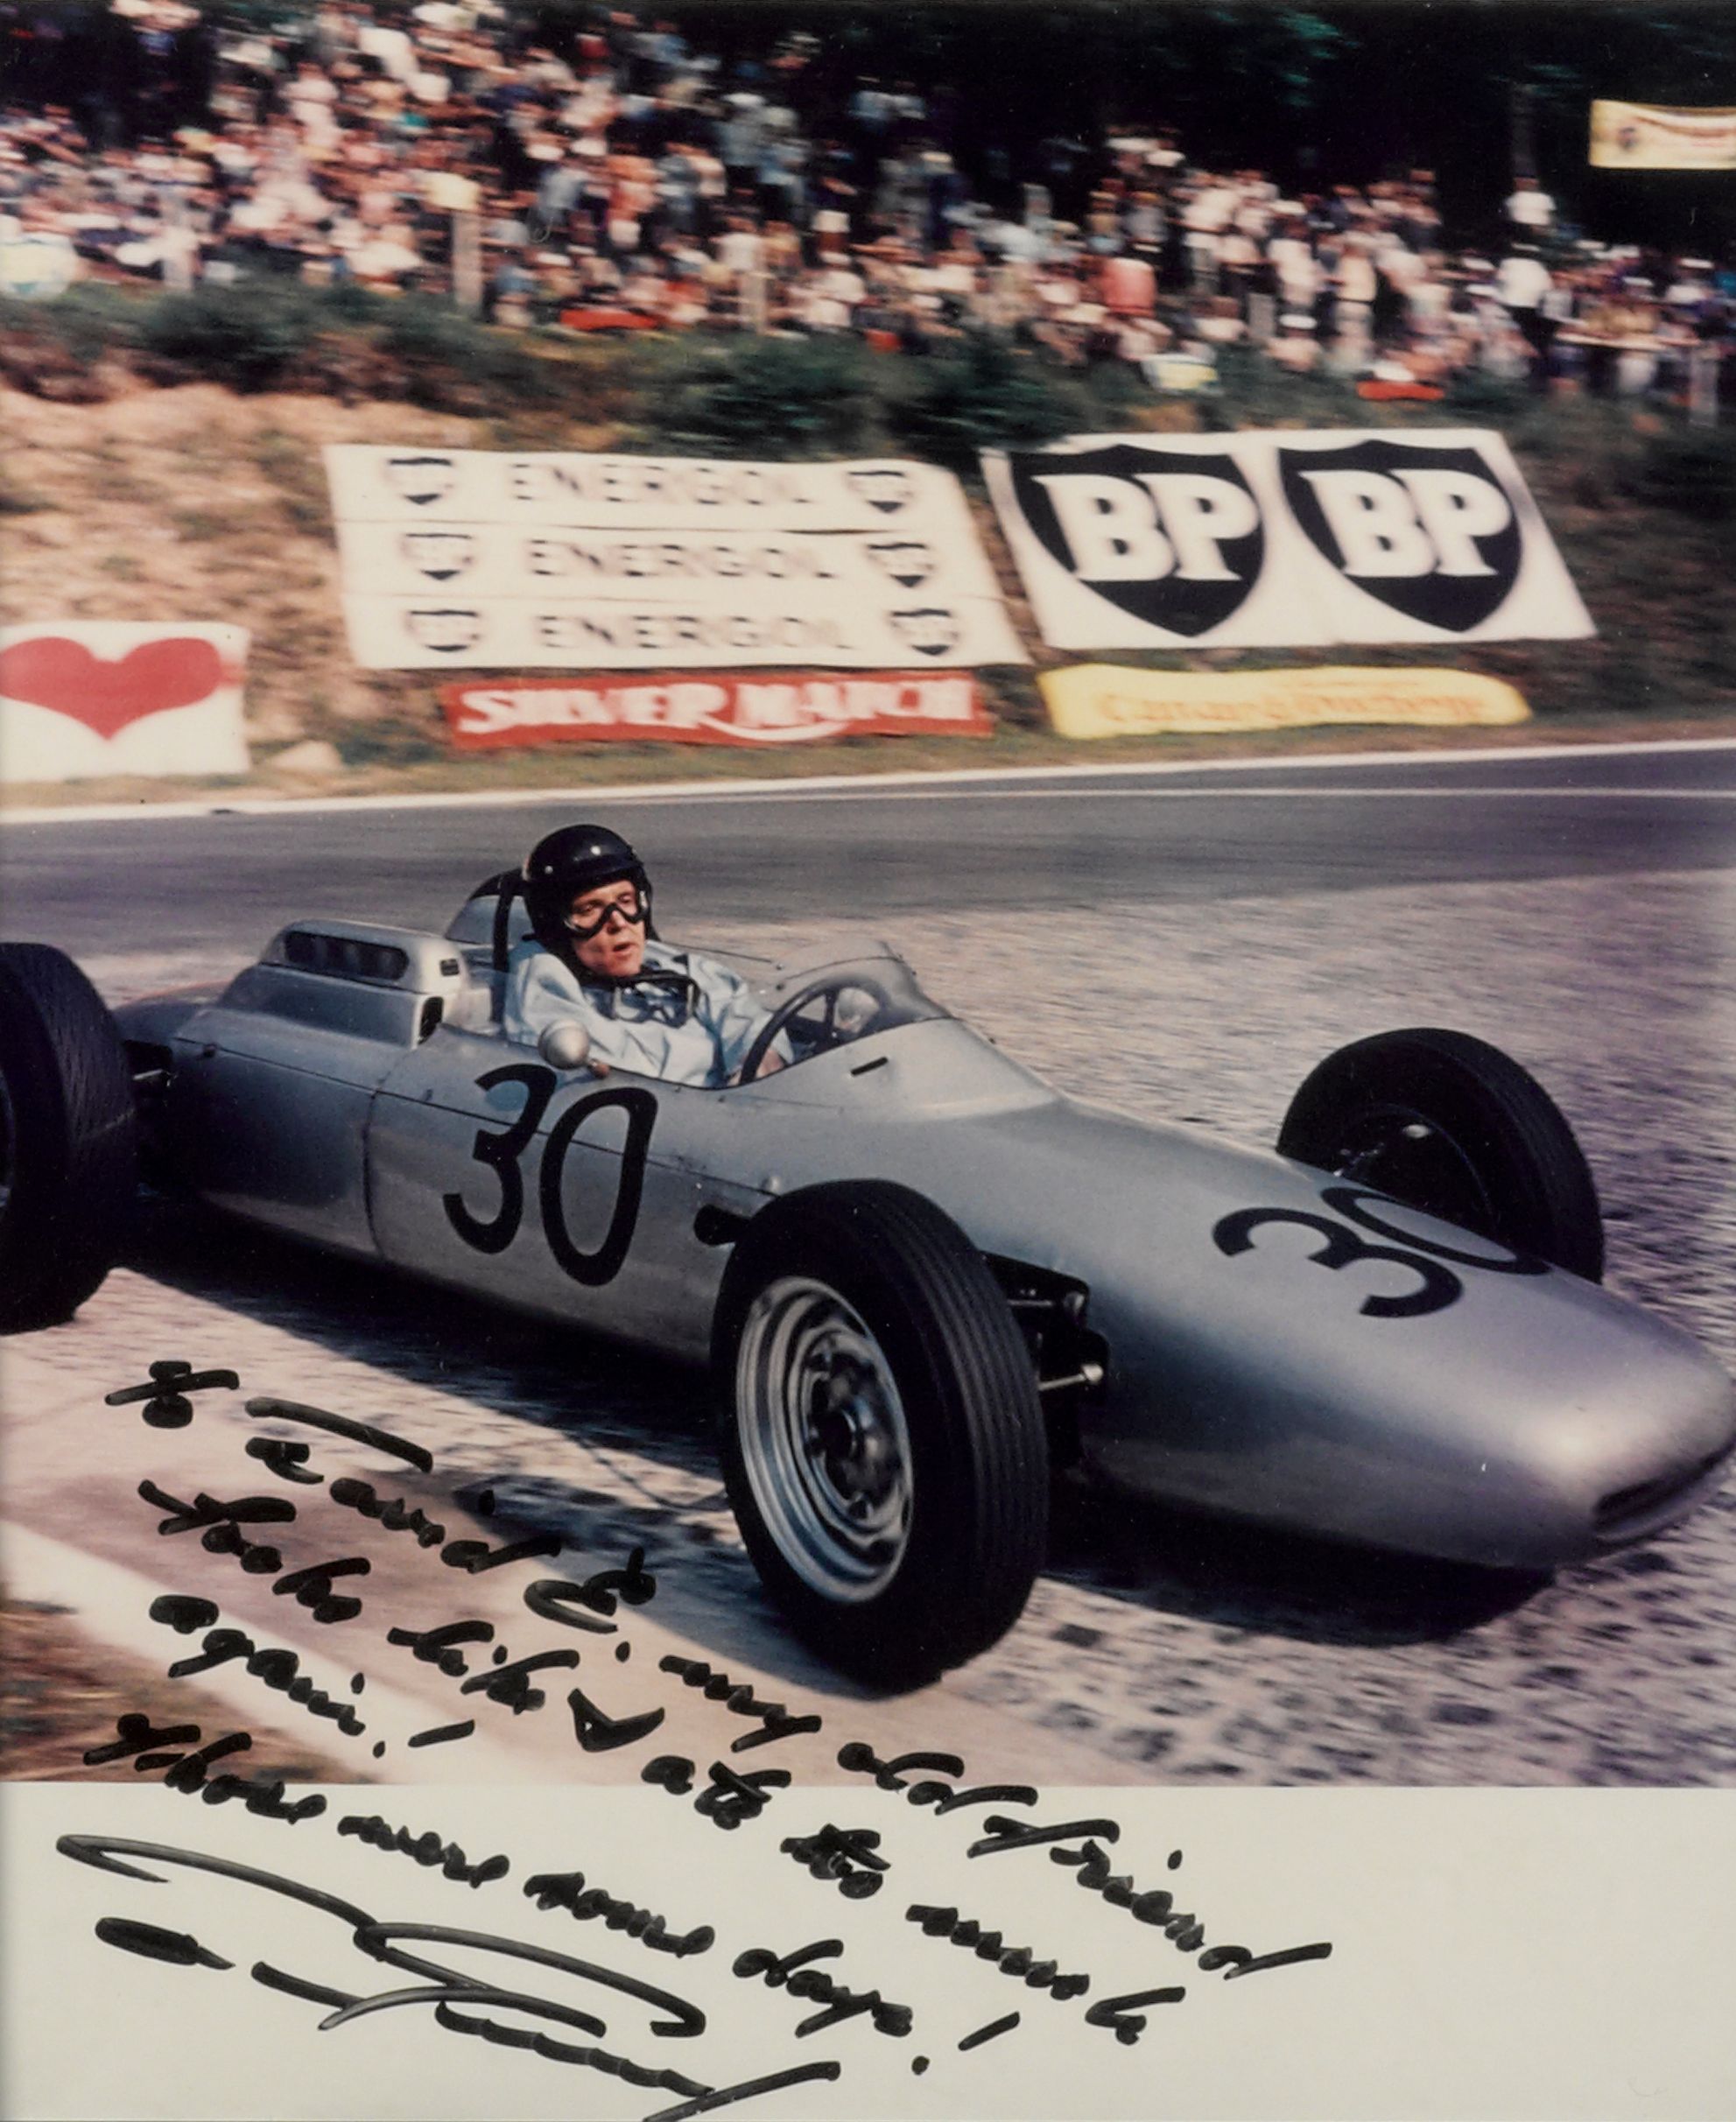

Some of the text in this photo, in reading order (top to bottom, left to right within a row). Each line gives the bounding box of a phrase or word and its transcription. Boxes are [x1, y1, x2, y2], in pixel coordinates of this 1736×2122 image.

[513, 463, 812, 505] ENERGOL
[1031, 473, 1261, 581] BP
[1299, 468, 1513, 578] BP
[530, 538, 837, 579] ENERGOL
[538, 615, 853, 649] ENERGOL
[441, 1062, 659, 1287] 30
[1212, 1186, 1553, 1318] 30
[658, 1655, 823, 1753] my
[837, 1742, 1038, 1816] old
[968, 1816, 1332, 1979] friend
[337, 1815, 510, 1888] were
[524, 1872, 715, 1959] some
[906, 1904, 1186, 2046] much
